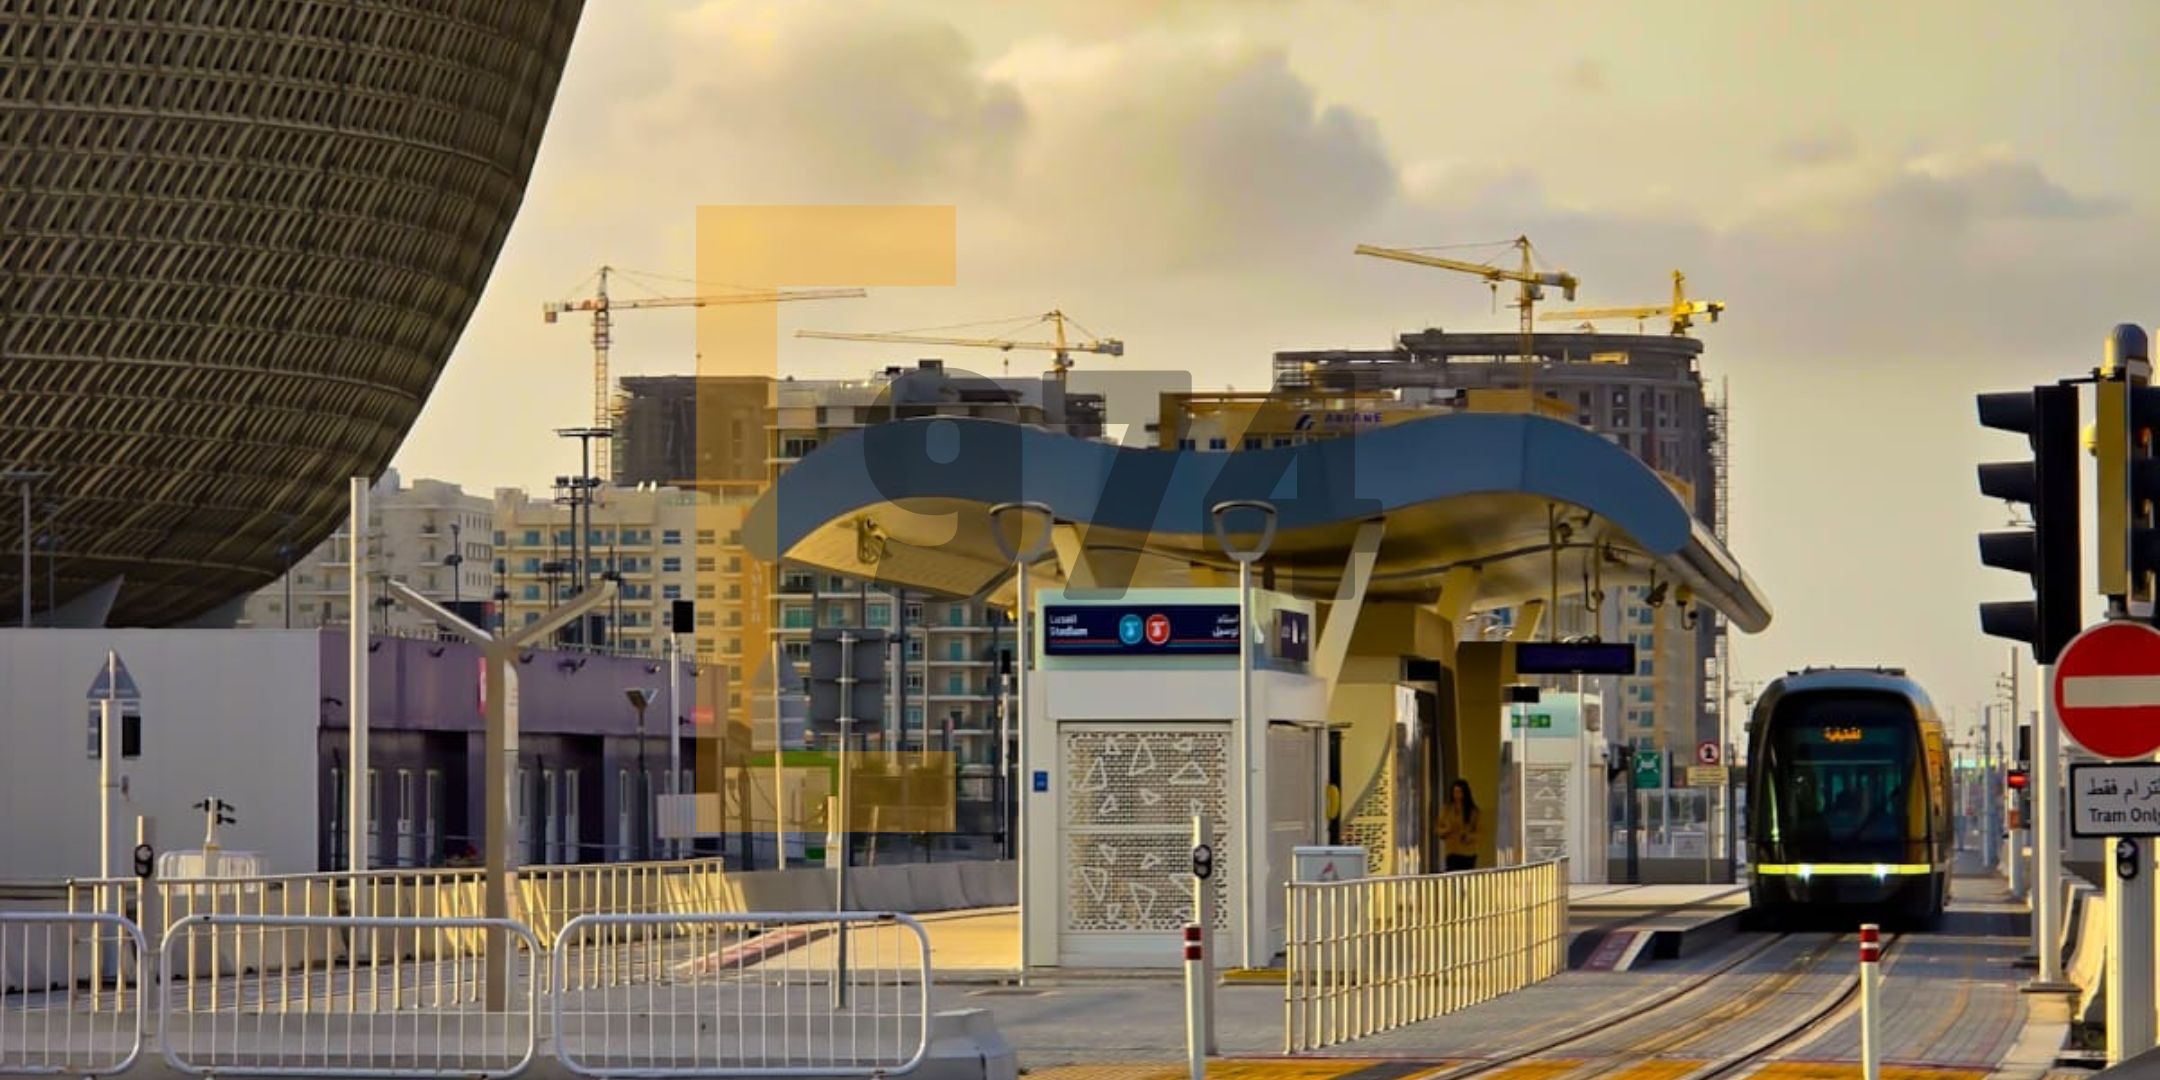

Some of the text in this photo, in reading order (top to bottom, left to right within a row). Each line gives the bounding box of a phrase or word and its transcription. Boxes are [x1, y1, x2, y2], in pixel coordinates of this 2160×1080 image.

[1050, 626, 1088, 637] Stadium
[2087, 776, 2118, 796] فقط
[2088, 807, 2127, 824] Tram
